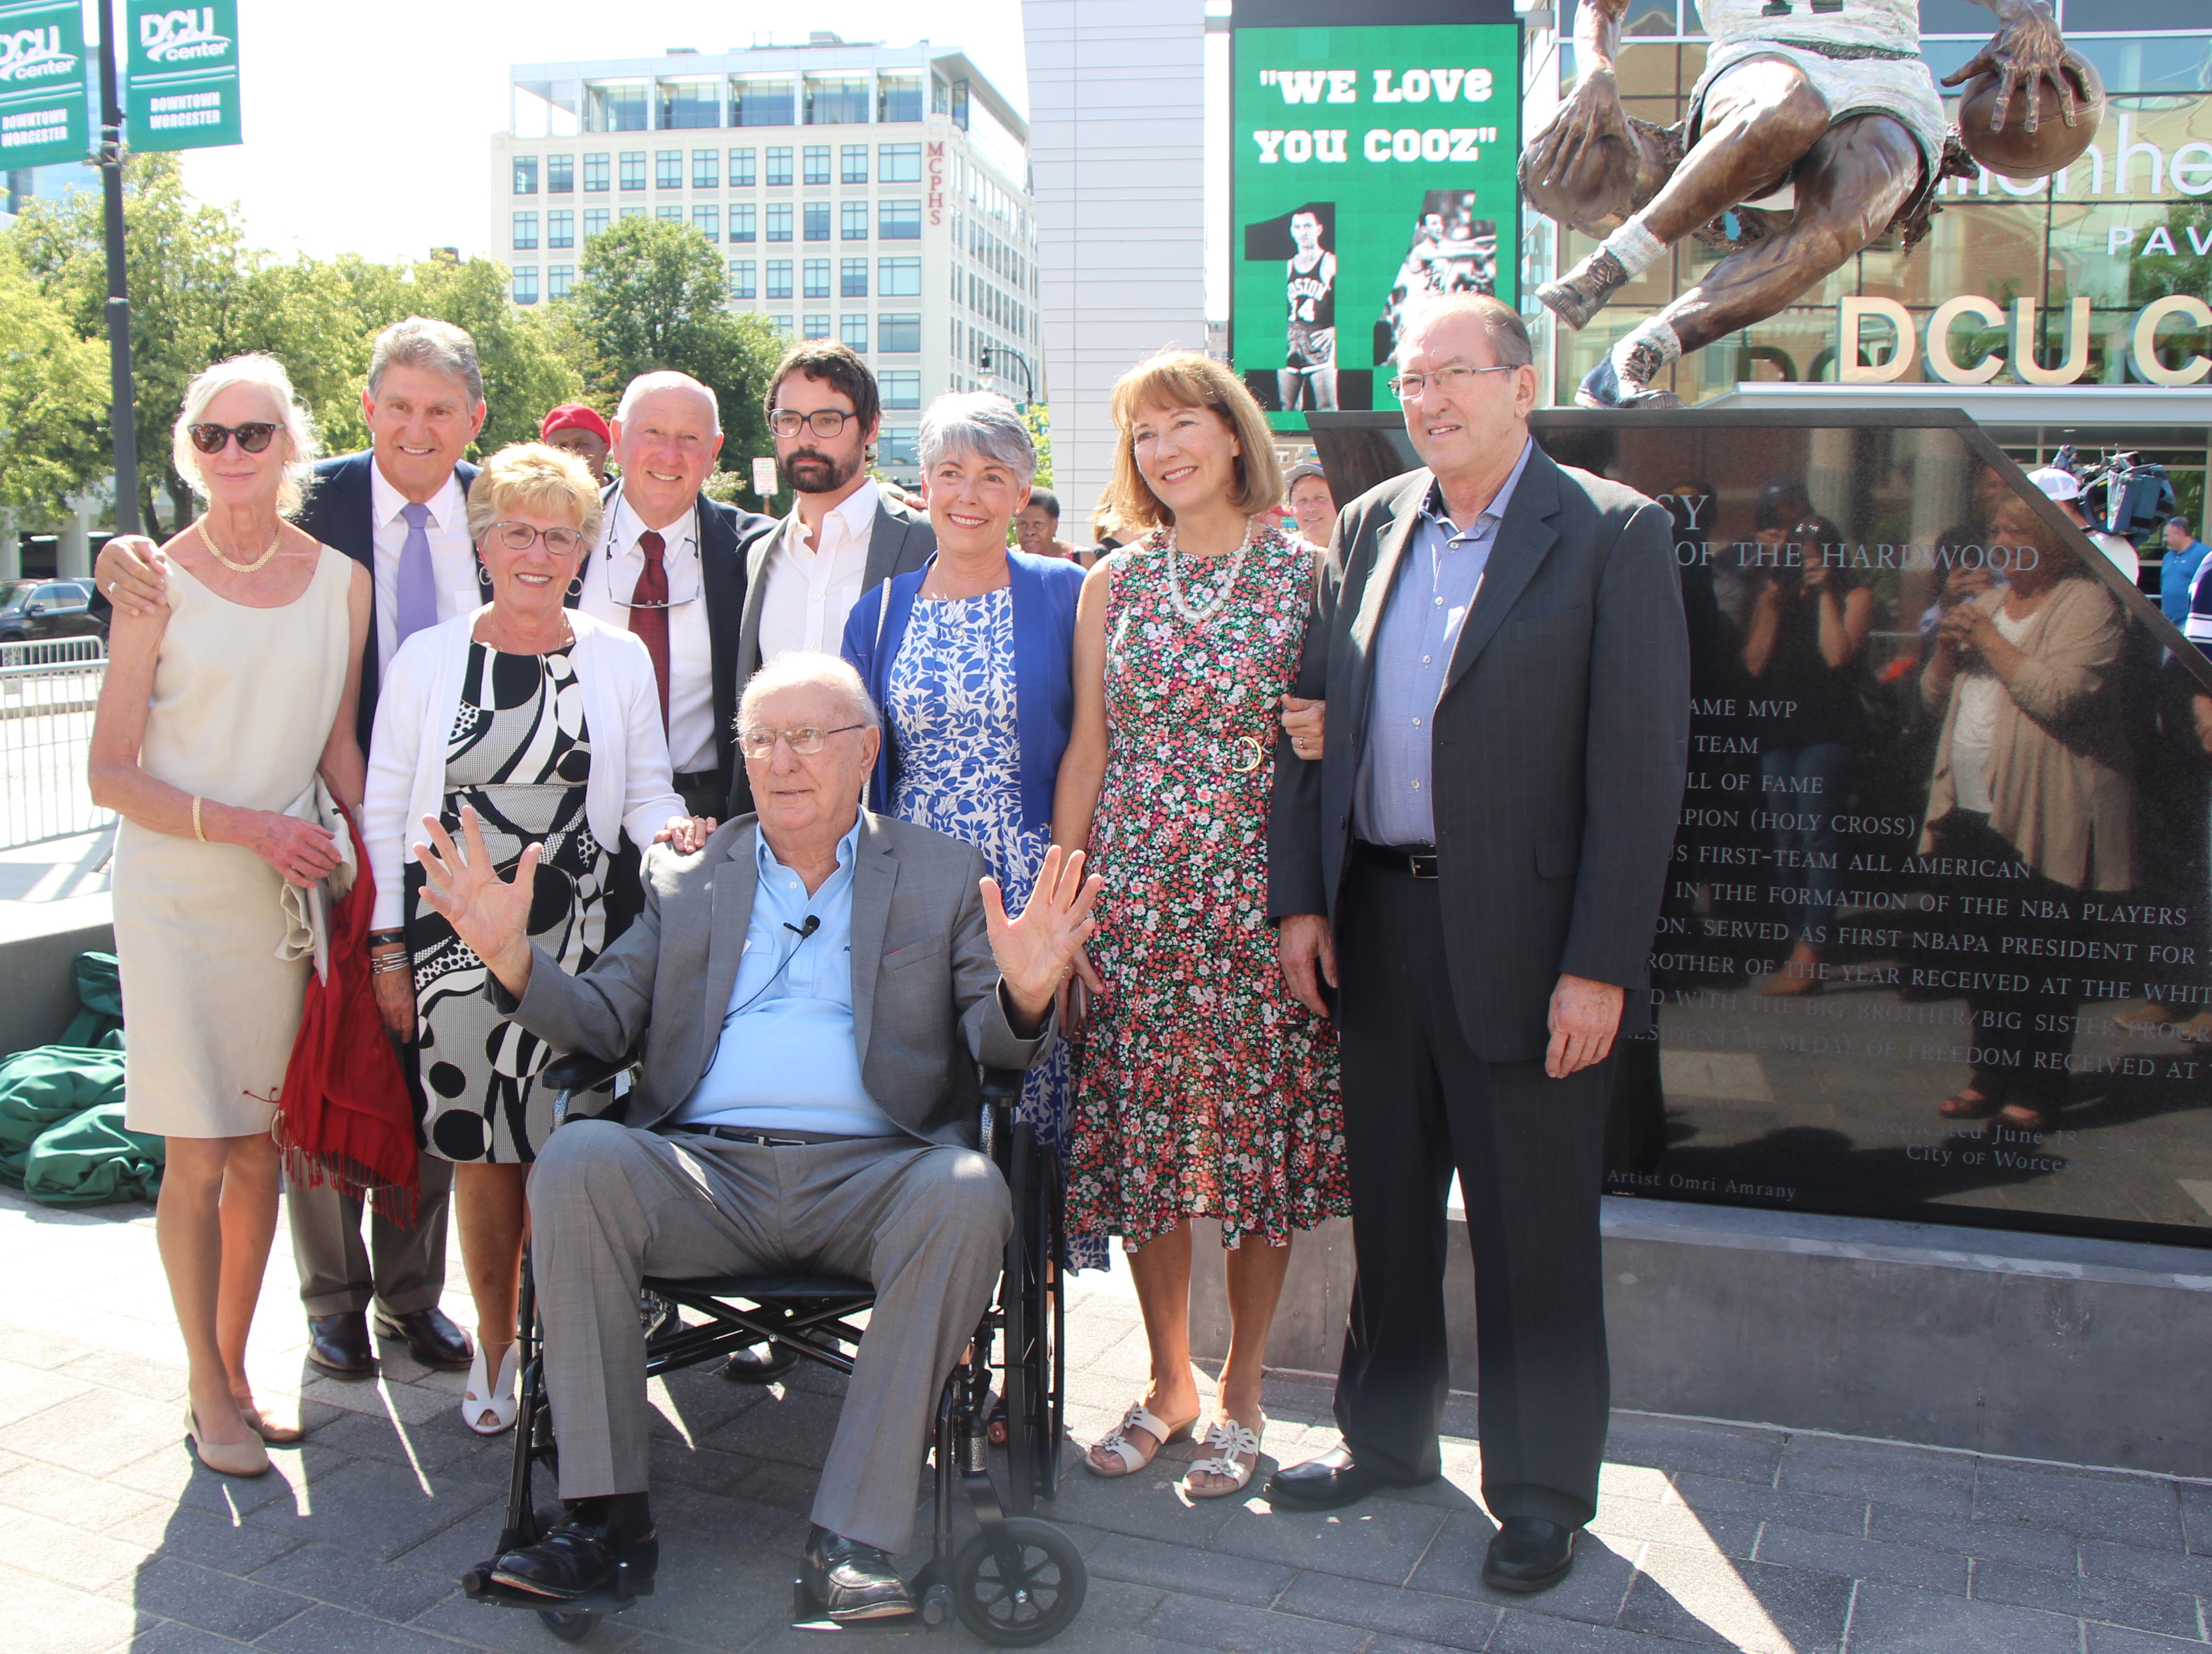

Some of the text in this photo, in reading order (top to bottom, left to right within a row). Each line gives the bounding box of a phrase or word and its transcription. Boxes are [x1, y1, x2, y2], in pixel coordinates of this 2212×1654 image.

[140, 6, 214, 46] DCU
[165, 42, 229, 61] center
[15, 59, 75, 80] center
[150, 91, 220, 112] DOWNTOWN
[1259, 69, 1356, 104] "WE
[2, 108, 67, 130] DOWNTOWN
[150, 109, 220, 129] WORCESTER
[1, 125, 68, 147] WORCESTER
[1253, 127, 1497, 163] YOU COOZ"
[927, 141, 945, 225] MCPHS
[2107, 226, 2212, 255] PAV
[1836, 295, 2091, 386] DCU
[1675, 541, 2039, 571] OF THE HARDWOOD
[1748, 700, 1798, 717] MVP
[1695, 735, 1759, 754] TEAM
[1721, 773, 1750, 790] OF
[1760, 775, 1824, 794] FAME
[1751, 808, 1822, 832] (HOLY
[1831, 815, 1915, 839] CROSS)
[1699, 846, 1839, 869] FIRST-TEAM
[1849, 854, 1891, 872] ALL
[1901, 856, 2031, 879] AMERICAN
[1675, 881, 2187, 925] IN THE FORMATION OF THE NBA PLAYERS
[1704, 919, 1789, 940] SERVED
[1799, 926, 1827, 943] AS
[1838, 927, 1902, 947] FIRST
[1911, 931, 1990, 952] NBAPA
[2001, 936, 2138, 961] PRESIDENT
[2148, 945, 2196, 965] FOR
[1745, 958, 1774, 975] OF
[1784, 961, 1830, 980] THE
[1841, 964, 1900, 984] YEAR
[1911, 968, 2029, 992] RECEIVED
[2040, 977, 2071, 994] AT
[2082, 979, 2132, 999] THE
[2143, 983, 2212, 1003] WHIT
[1675, 990, 1738, 1010] WITH
[1752, 995, 1794, 1014] THE
[1807, 999, 1843, 1018] BIG
[1858, 1003, 2021, 1029] BROTHER/BIG
[2035, 1014, 2115, 1036] SISTER
[1867, 1040, 1895, 1057] OF
[1909, 1043, 2021, 1066] FREEDOM
[2034, 1051, 2155, 1076] RECEIVED
[2166, 1062, 2199, 1079] AT
[1993, 1124, 2043, 1145] June
[1907, 1145, 1952, 1166] City
[1962, 1151, 1986, 1165] OF
[1607, 1170, 1796, 1201] Artist Omri Amrany
